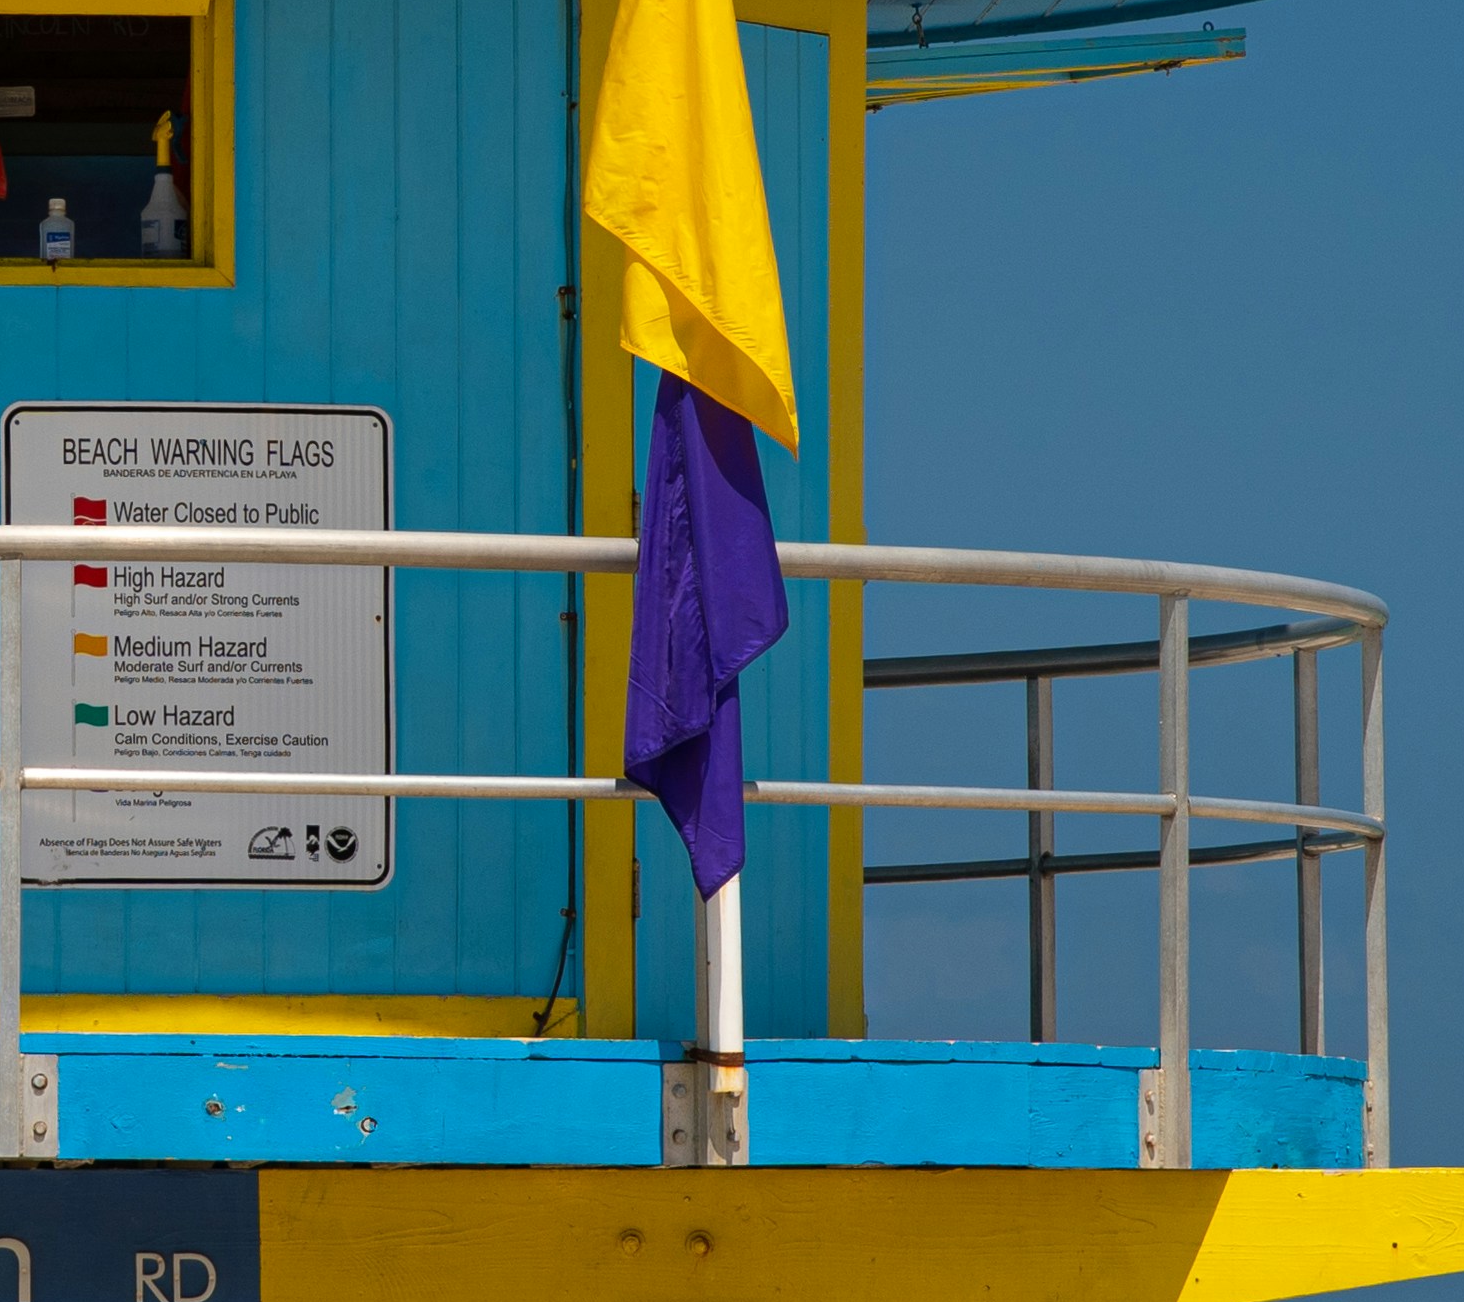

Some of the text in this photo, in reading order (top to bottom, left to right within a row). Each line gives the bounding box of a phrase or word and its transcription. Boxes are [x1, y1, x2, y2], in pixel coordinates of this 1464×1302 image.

[63, 438, 334, 467] BEACH WARNING FLAGS
[103, 469, 296, 479] BANDERAS DE ADVERTENCIA EN LA PLAYA
[114, 502, 320, 525] Water Closed to Public
[114, 566, 224, 592] High Hazard
[114, 593, 300, 608] High Surf and/or Strong Currents
[114, 610, 140, 618] Peligro
[204, 610, 215, 619] y/o
[114, 636, 267, 658] Medium Hazard
[114, 660, 302, 673] Moderate Surf and/or Currents
[114, 676, 140, 684] Peligro
[236, 676, 247, 685] y/o
[114, 705, 234, 726] Low Hazard
[114, 733, 328, 747] Calm Conditions, Exercise Caution
[114, 750, 140, 758] Peligro
[240, 750, 262, 758] Tenga
[159, 799, 192, 808] Peligrosa
[40, 838, 222, 848] Absence of Flags Does Not Assure Safe Waters
[170, 849, 190, 858] Aguas
